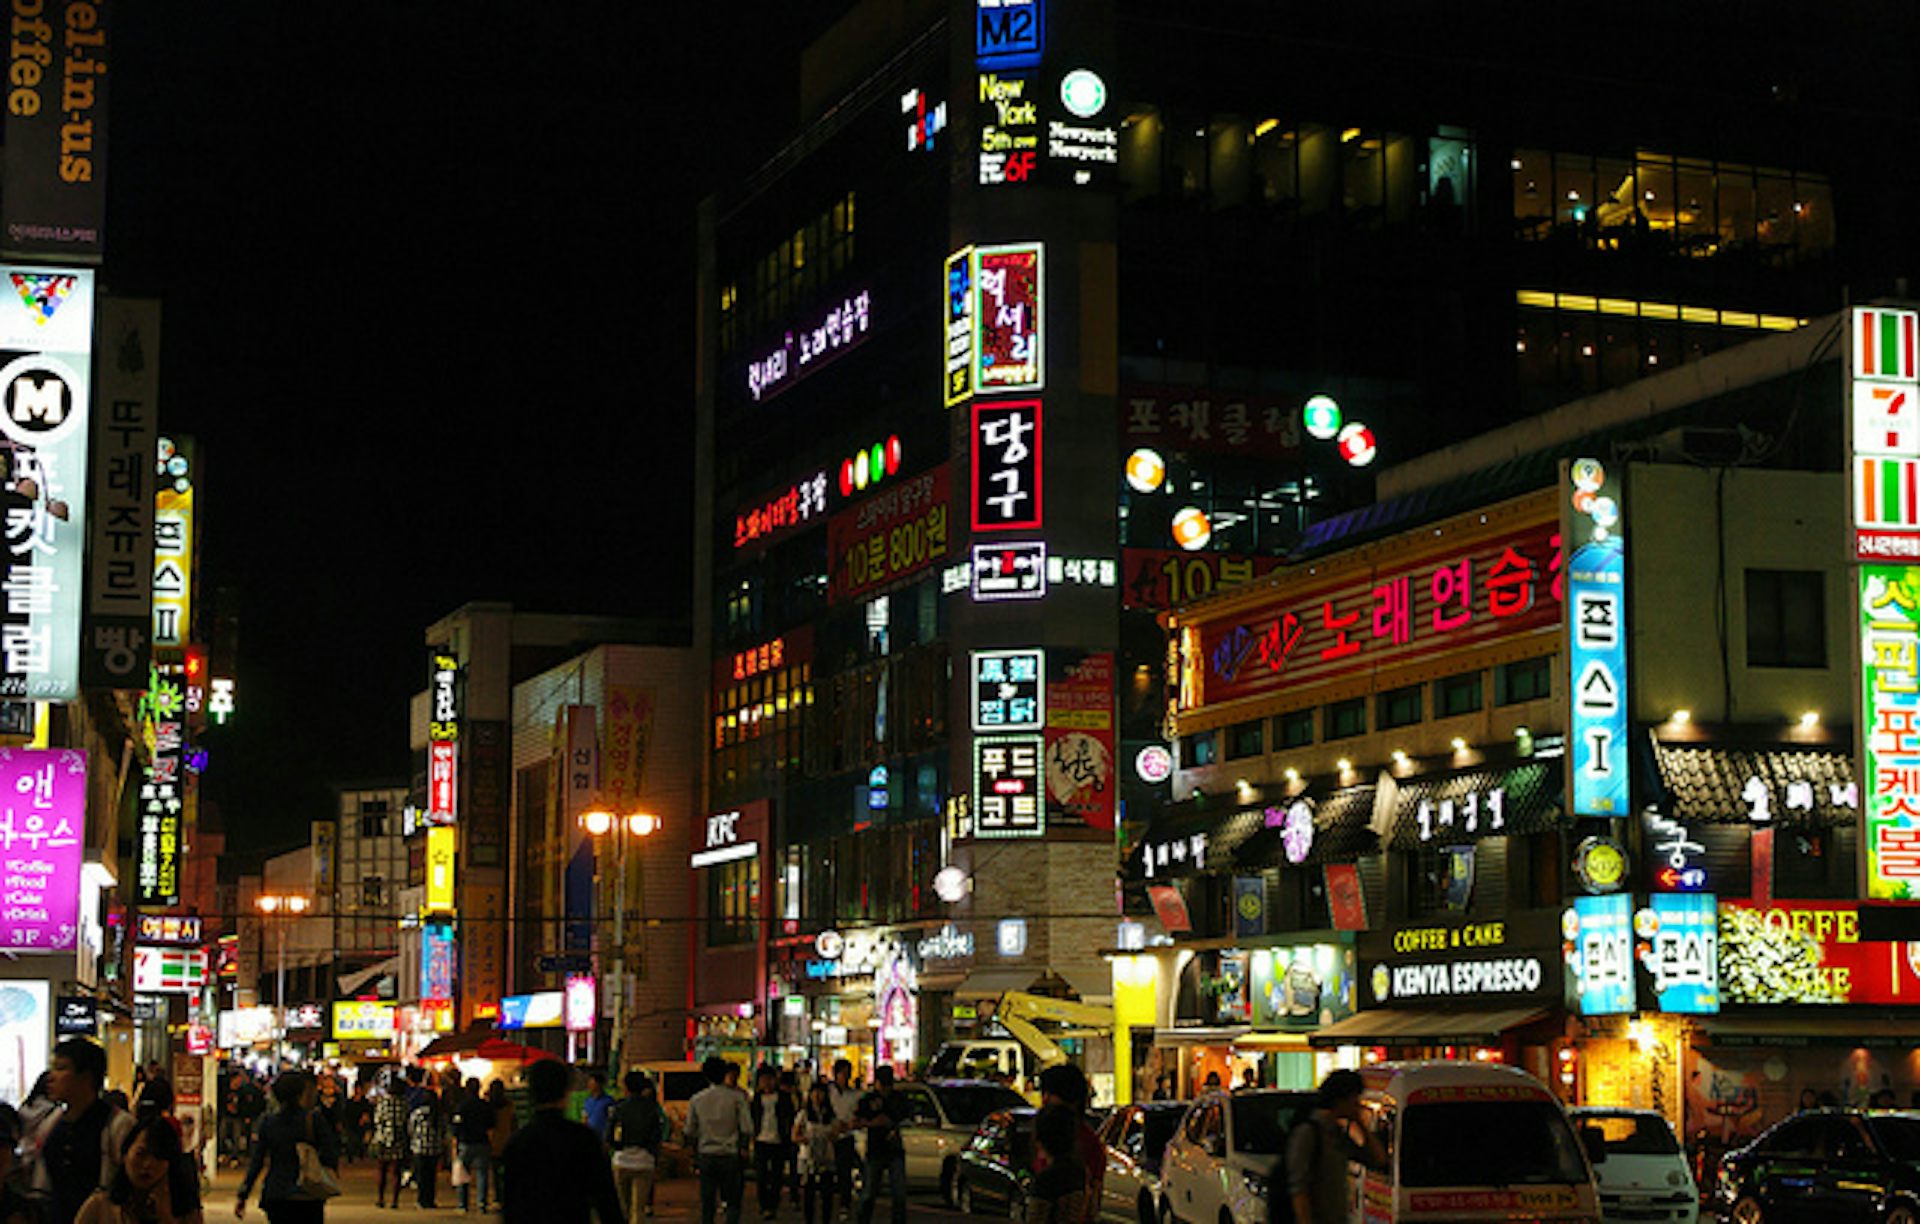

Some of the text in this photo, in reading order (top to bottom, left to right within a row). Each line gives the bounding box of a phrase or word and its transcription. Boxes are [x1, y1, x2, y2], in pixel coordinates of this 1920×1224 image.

[982, 10, 1032, 47] M2
[979, 73, 1024, 103] New
[995, 98, 1037, 127] York
[1005, 151, 1037, 182] 6F
[13, 376, 65, 423] M
[979, 411, 1035, 518] 당구
[103, 400, 145, 602] 뚜레쥬르
[889, 501, 947, 573] 800원
[95, 626, 145, 676] 빵
[982, 747, 1036, 780] 푸드
[16, 763, 55, 809] 앤
[982, 795, 1037, 827] 코트
[11, 928, 40, 945] 3F
[1393, 927, 1448, 952] COFFEE
[1463, 922, 1505, 947] CAKE
[1392, 958, 1542, 998] KENYA ESPRESSO
